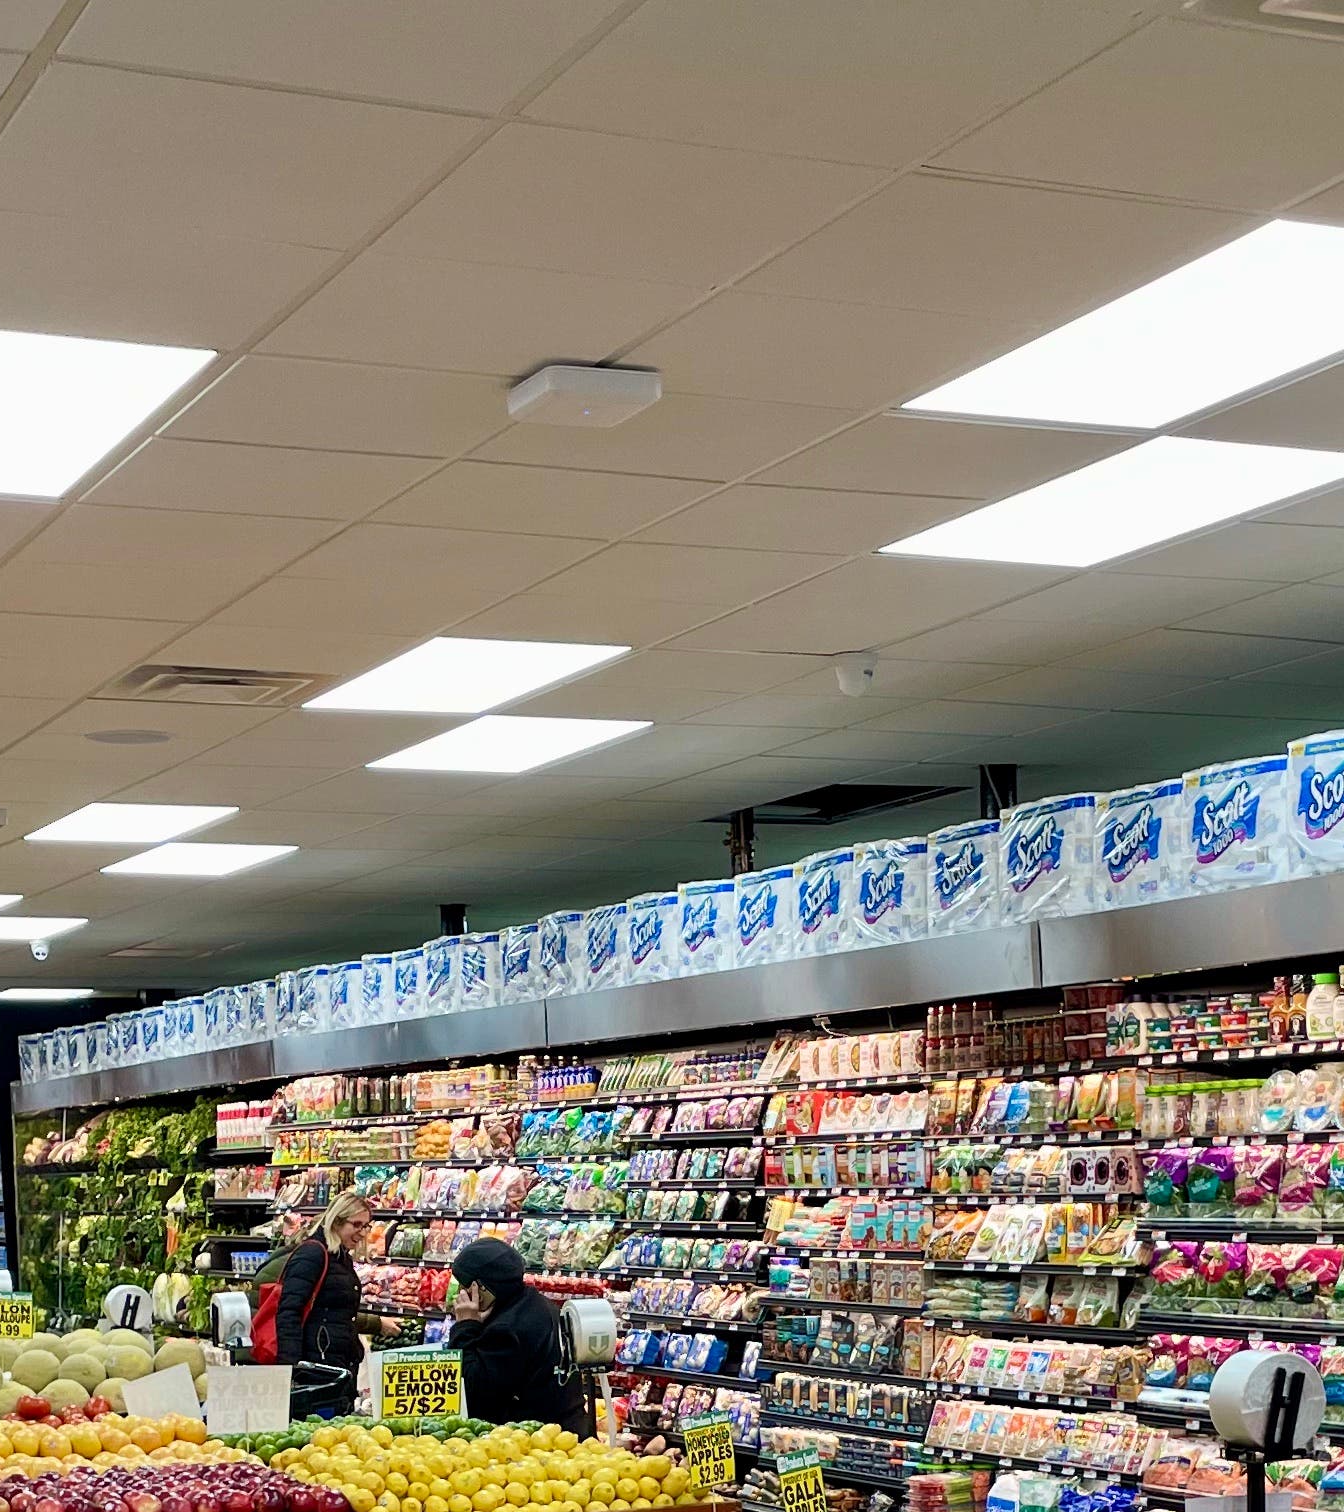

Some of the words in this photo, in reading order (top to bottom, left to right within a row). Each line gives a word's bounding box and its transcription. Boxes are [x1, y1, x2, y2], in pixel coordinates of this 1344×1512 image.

[1200, 780, 1249, 847] Scott
[1322, 802, 1344, 832] 1000
[1016, 818, 1054, 875] Scott
[1111, 804, 1153, 867] Scott
[1212, 830, 1235, 858] 1000
[941, 842, 975, 896] Scott
[866, 862, 898, 908] Scott
[399, 1354, 431, 1362] Produce
[384, 1382, 457, 1397] LEMONS
[385, 1369, 458, 1383] YELLOW
[395, 1397, 446, 1416] 5/$2
[690, 1445, 733, 1467] APPLES
[699, 1462, 725, 1487] $2.99
[784, 1478, 822, 1506] GALA
